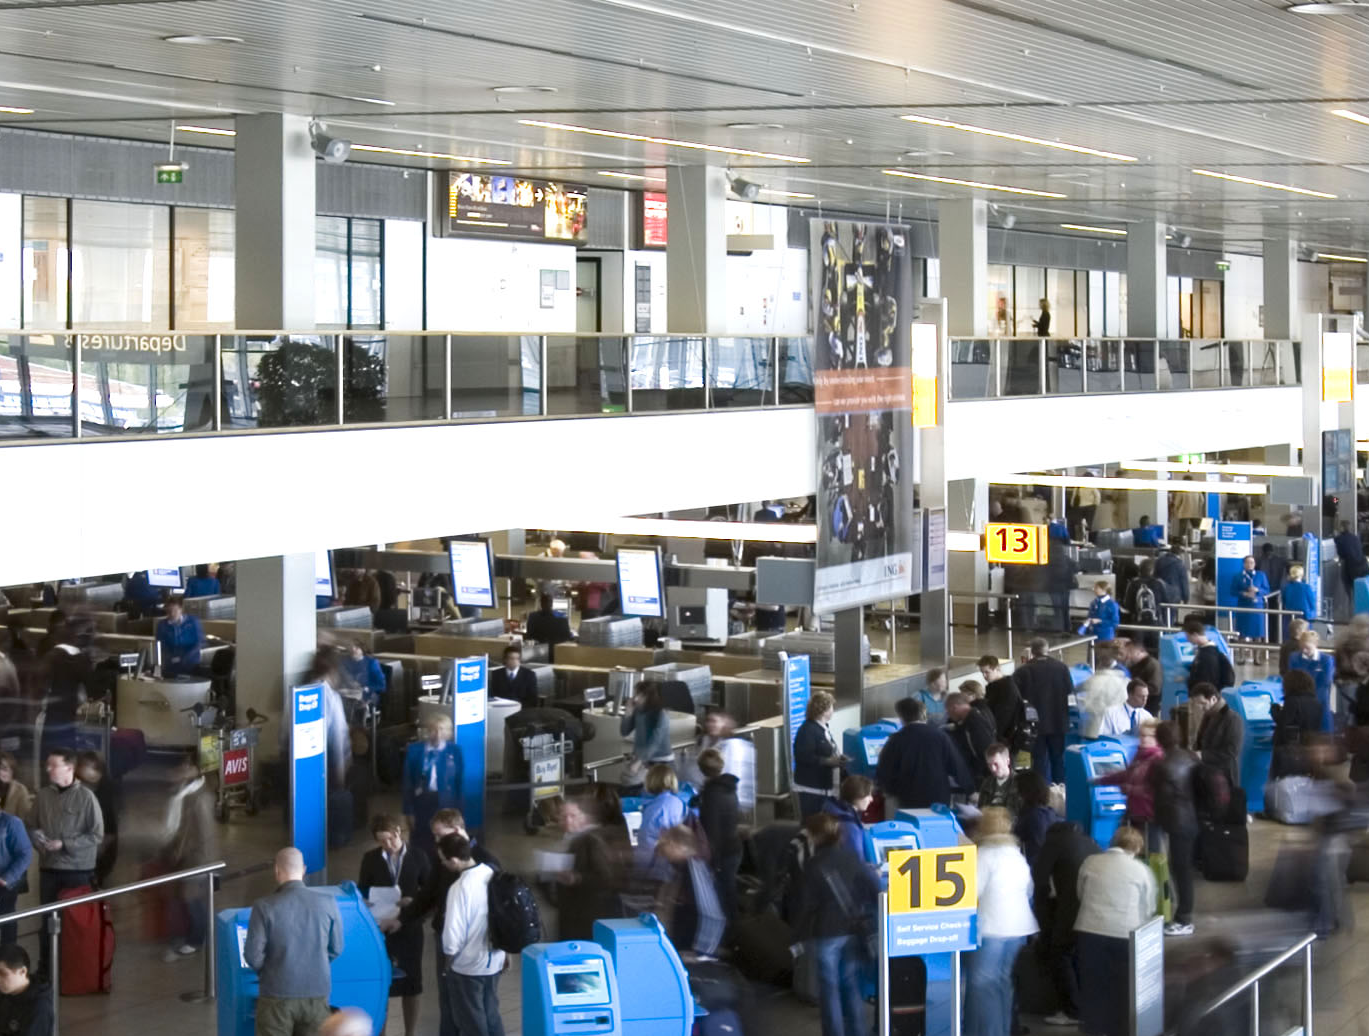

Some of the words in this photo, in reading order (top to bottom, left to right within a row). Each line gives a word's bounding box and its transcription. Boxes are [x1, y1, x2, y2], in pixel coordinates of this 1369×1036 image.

[996, 528, 1029, 552] 13
[884, 565, 897, 577] ING
[225, 757, 247, 776] AVIS
[897, 852, 966, 908] 15
